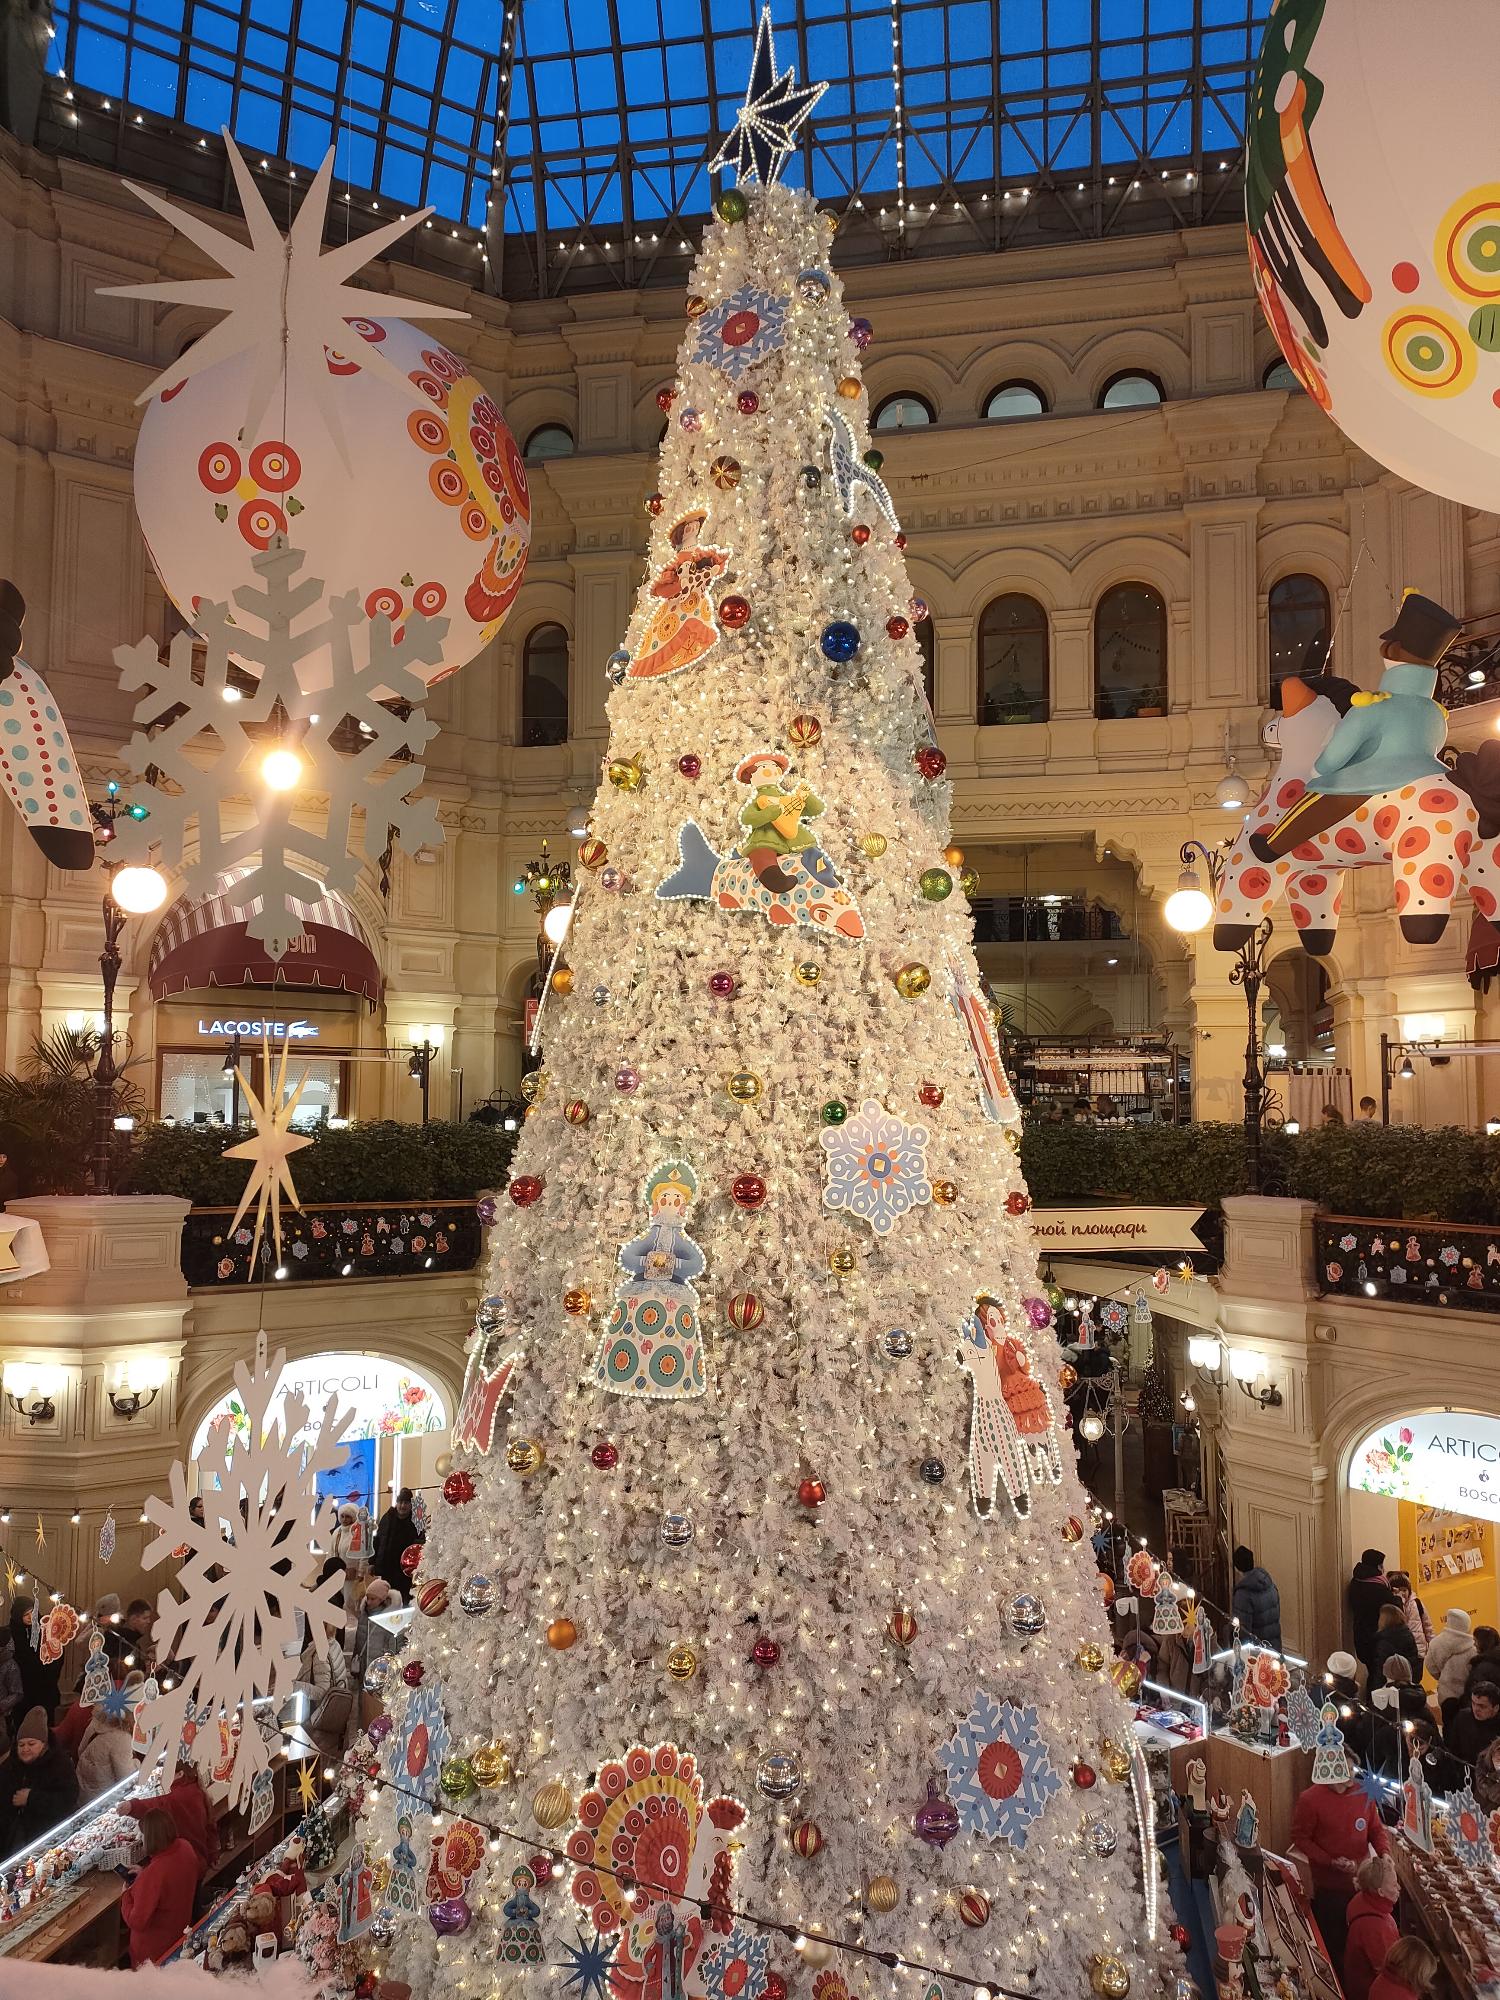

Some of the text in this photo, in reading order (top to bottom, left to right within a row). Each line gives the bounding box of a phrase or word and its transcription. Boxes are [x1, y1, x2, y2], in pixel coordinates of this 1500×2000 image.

[198, 1019, 285, 1036] LACOSTE
[1071, 1222, 1148, 1240] площади
[276, 1374, 379, 1399] ARTICOLI
[1427, 1434, 1500, 1462] ARTIC
[1459, 1486, 1500, 1504] BOSC
